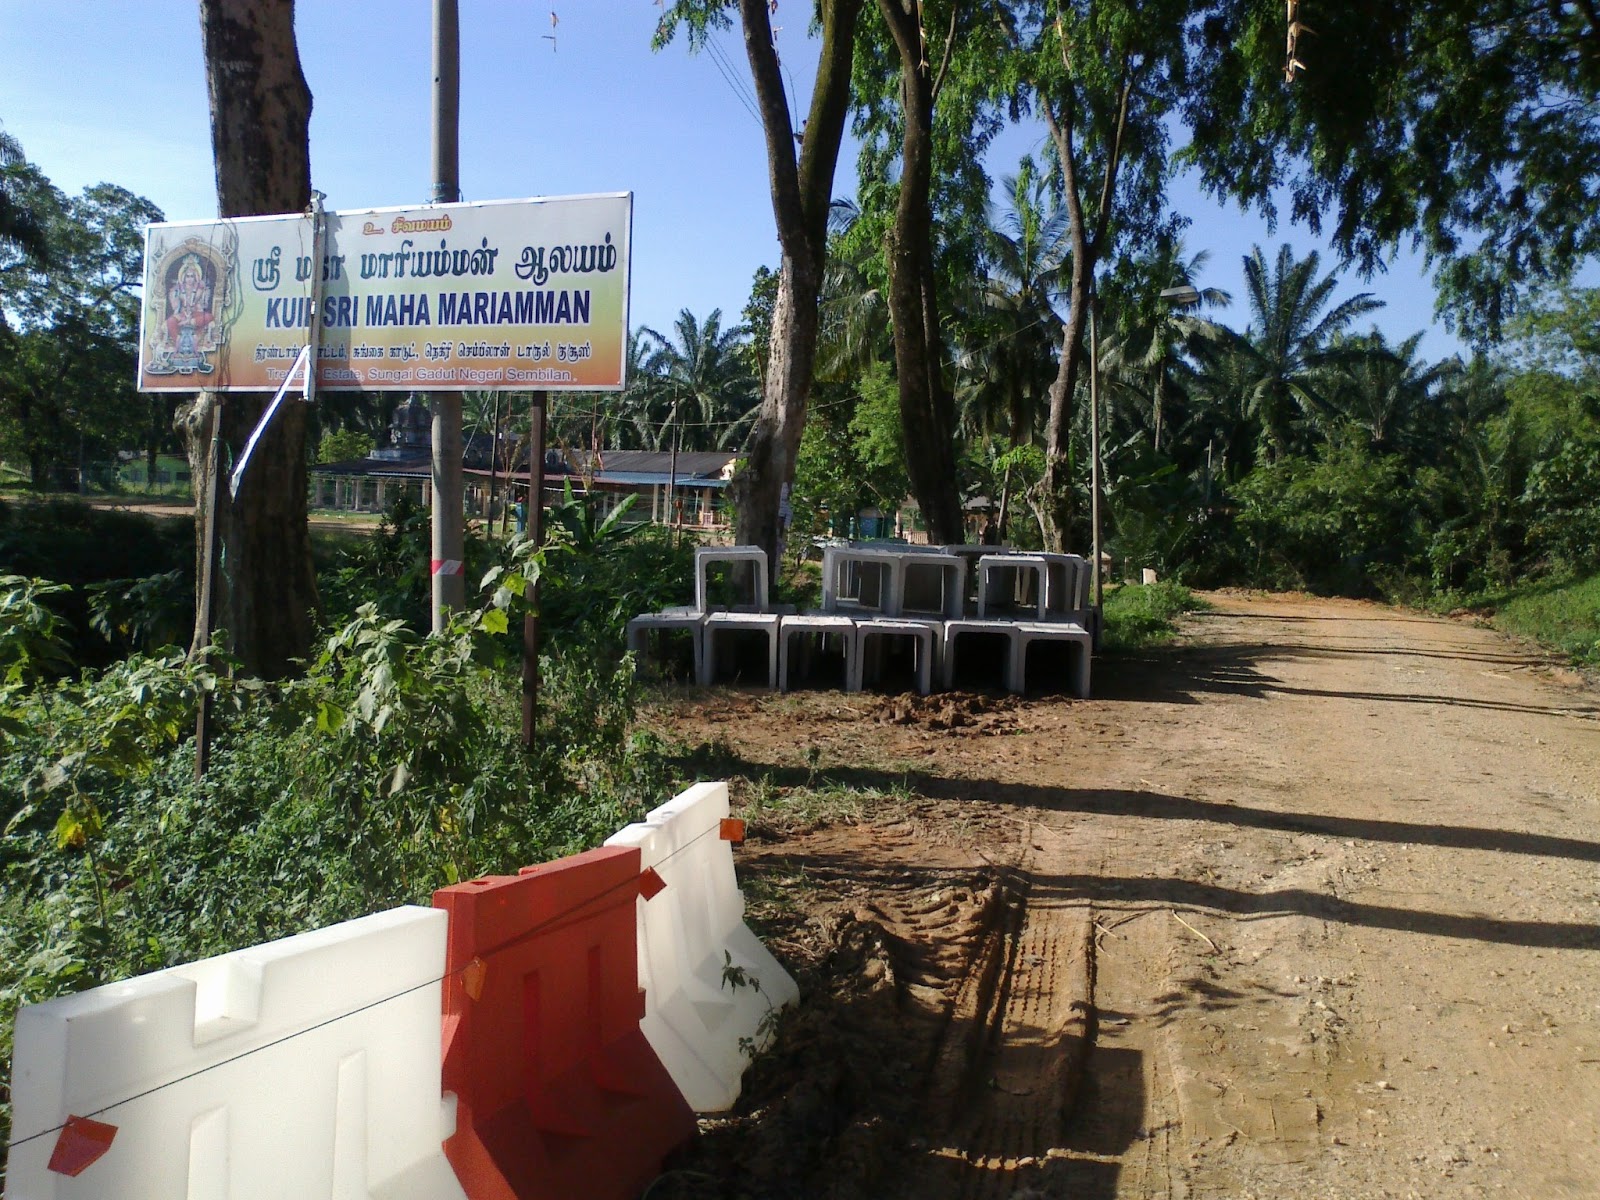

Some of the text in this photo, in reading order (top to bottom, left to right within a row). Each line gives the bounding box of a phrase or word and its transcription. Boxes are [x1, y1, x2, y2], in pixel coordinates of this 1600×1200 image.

[360, 237, 499, 279] மாரியம்மன்
[515, 231, 617, 286] ஆலயம்
[323, 296, 358, 327] SRI
[366, 294, 430, 326] MAHA
[438, 290, 590, 325] MARIAMMAN
[368, 368, 413, 382] Sungai
[416, 367, 456, 380] Gadut
[459, 367, 502, 382] Negeri
